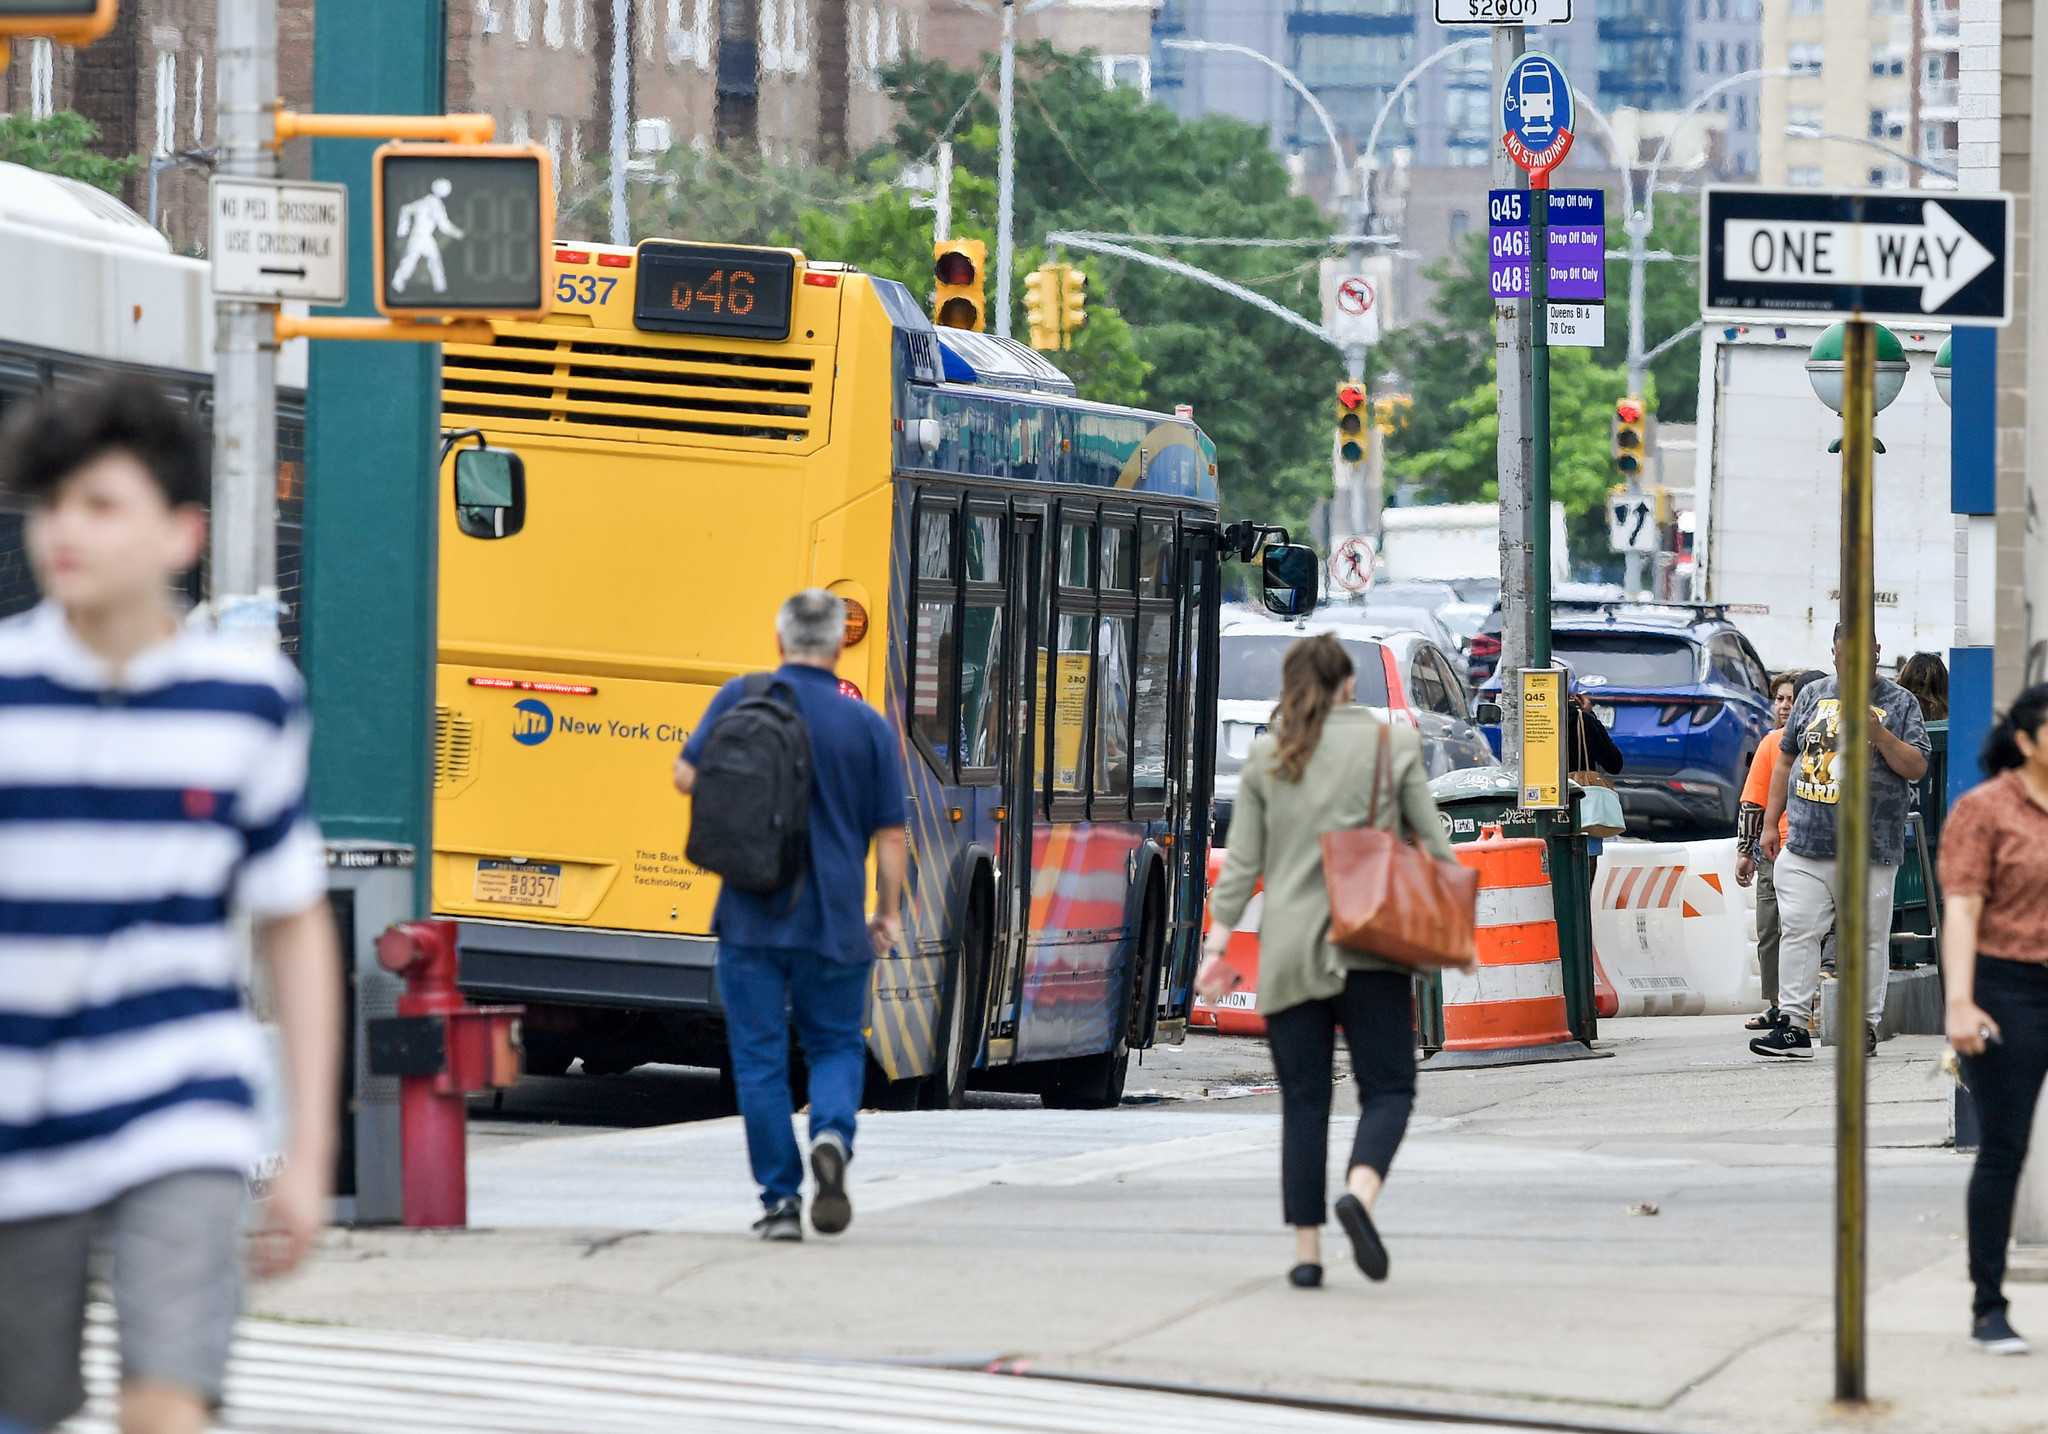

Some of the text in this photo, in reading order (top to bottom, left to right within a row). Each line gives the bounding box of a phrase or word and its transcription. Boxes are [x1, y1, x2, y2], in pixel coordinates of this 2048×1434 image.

[1507, 134, 1567, 167] NO STANDING
[220, 198, 236, 217] NO
[278, 201, 336, 224] CROSSING
[1491, 194, 1522, 221] Q45
[1549, 194, 1593, 209] Drop Off Only
[226, 230, 330, 257] USE CROSSWALK
[1493, 230, 1523, 257] Q46
[1550, 231, 1598, 246] Drop Off Only
[1751, 229, 1961, 279] ONE WAY
[1492, 267, 1522, 293] Q48
[1550, 267, 1599, 282] Drop Off Only
[552, 273, 618, 306] 537
[671, 269, 755, 315] Q46
[1550, 306, 1590, 319] Queens Bl &
[1550, 322, 1576, 335] 78 Cres
[1525, 693, 1545, 701] Q45
[559, 715, 602, 735] New
[607, 720, 650, 740] York
[635, 850, 679, 863] This Bus
[634, 863, 659, 874] Uses
[519, 876, 555, 898] 8357
[633, 876, 692, 890] Technology
